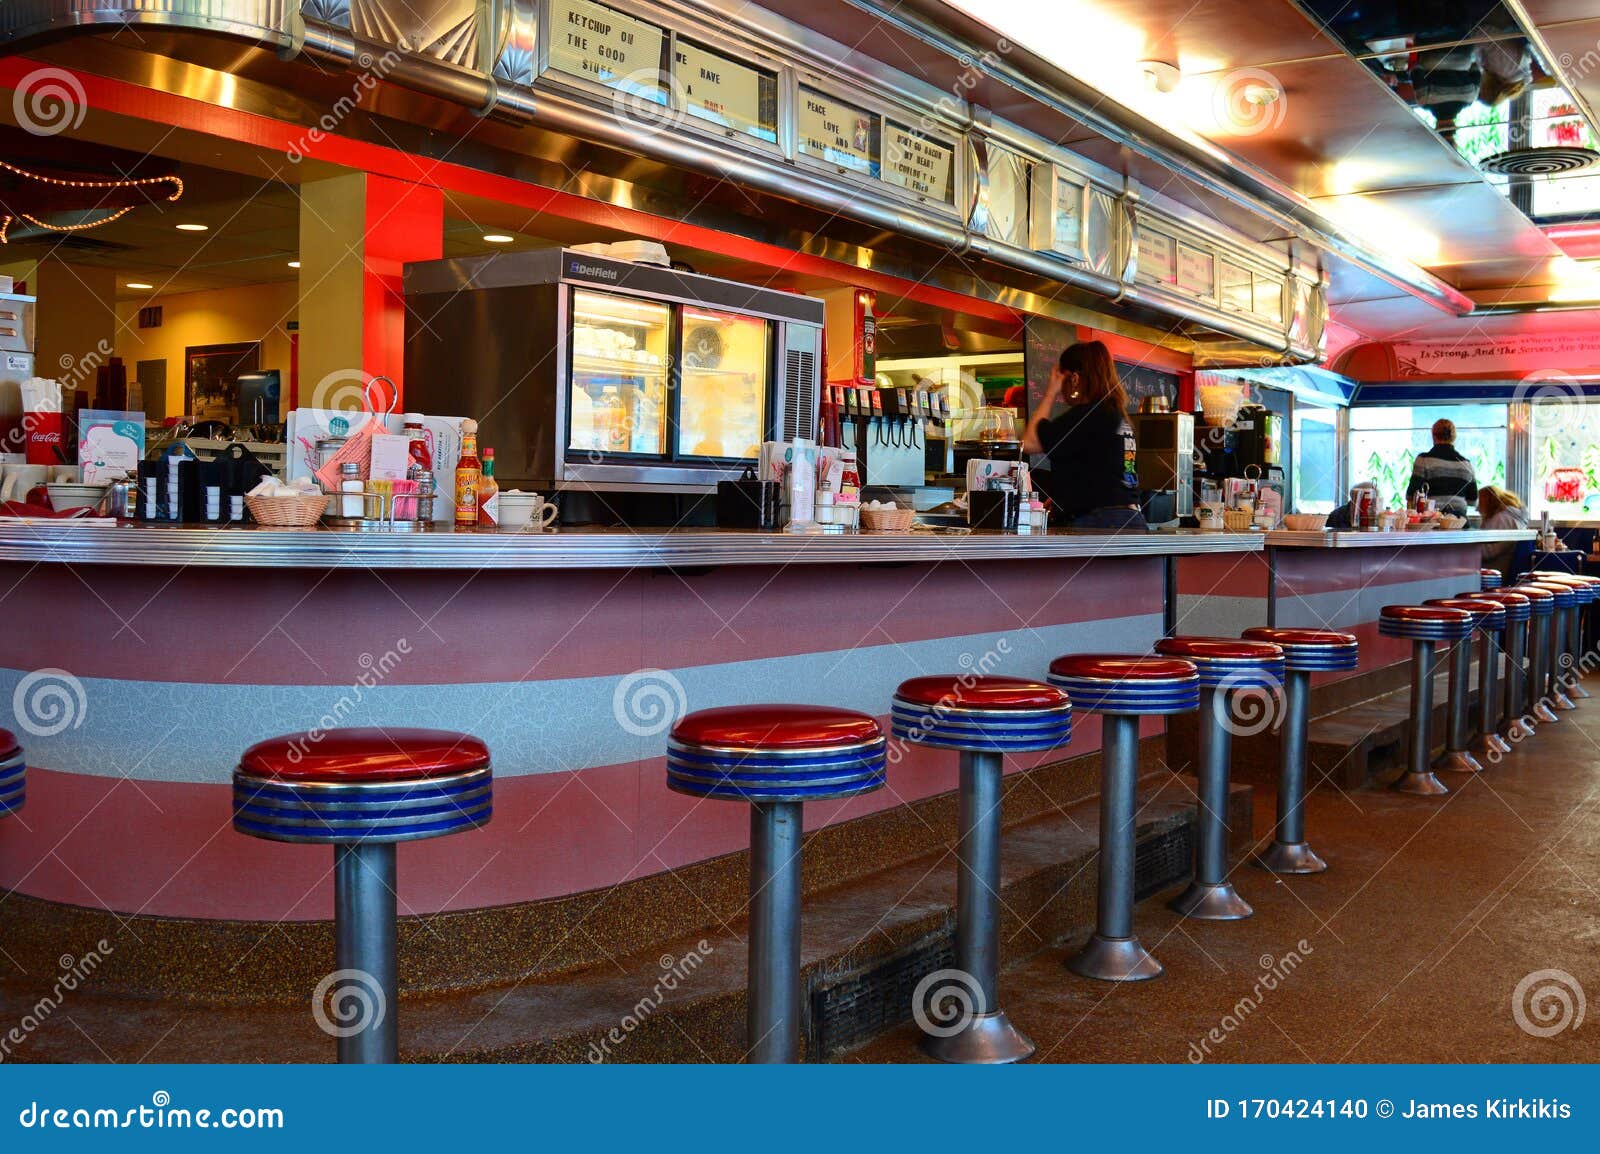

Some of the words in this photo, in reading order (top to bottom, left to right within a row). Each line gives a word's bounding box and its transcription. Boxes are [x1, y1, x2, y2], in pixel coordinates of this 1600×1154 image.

[568, 11, 611, 36] KETCHUP
[621, 30, 634, 45] ON
[567, 33, 588, 50] THE
[598, 45, 625, 64] GOOD
[582, 59, 613, 77] STUFF
[700, 68, 721, 84] HAVE
[687, 84, 693, 95] A
[807, 100, 826, 117] PEACE
[823, 120, 840, 135] LOVE
[835, 136, 849, 149] AND
[914, 142, 922, 152] GO
[924, 146, 943, 160] BACON
[904, 151, 913, 161] MY
[916, 156, 934, 169] HEART
[912, 180, 929, 193] FRIED
[930, 175, 937, 184] IF
[579, 264, 617, 279] Delfield
[1420, 350, 1430, 359] Is
[1472, 347, 1494, 357] And
[1496, 345, 1516, 355] The
